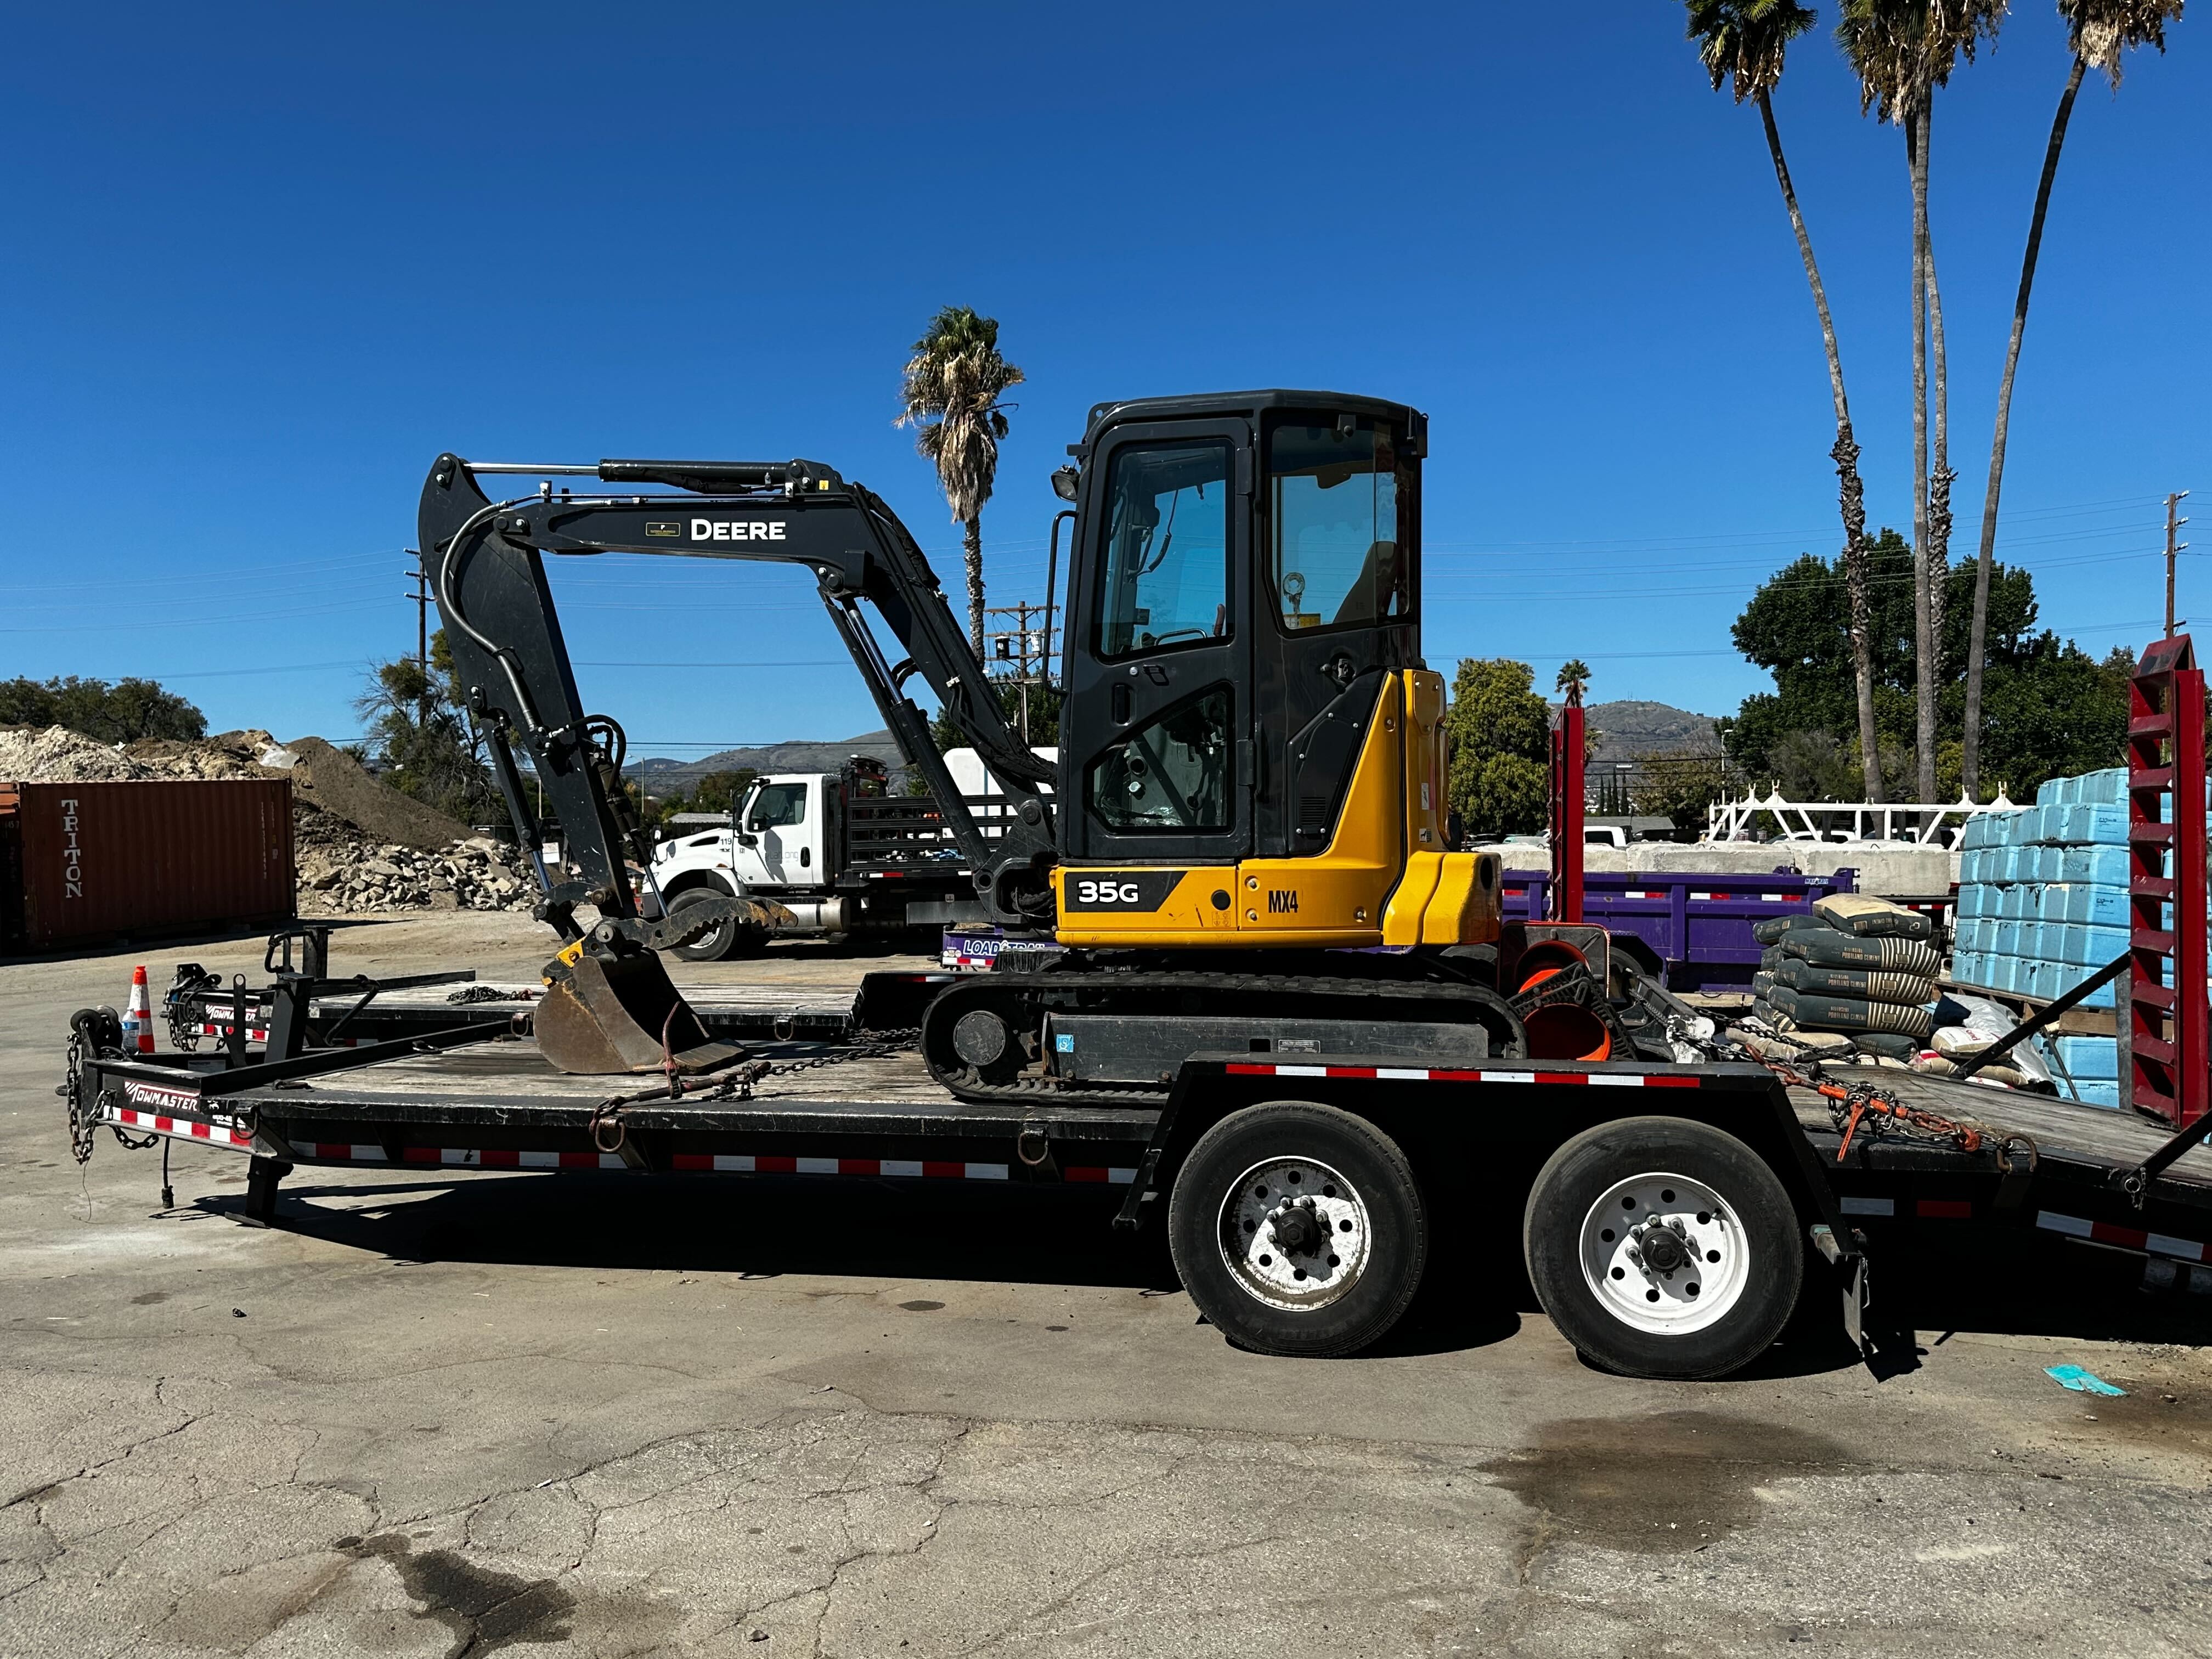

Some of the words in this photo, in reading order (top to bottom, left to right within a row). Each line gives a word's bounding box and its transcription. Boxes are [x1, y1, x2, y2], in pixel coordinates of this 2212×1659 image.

[691, 518, 786, 540] DEERE
[61, 799, 83, 898] TRITON
[1077, 880, 1139, 904] 35G
[1268, 890, 1299, 914] MX4
[963, 940, 1001, 956] LOAD
[1842, 952, 1863, 960] PORTLAND
[1828, 979, 1849, 987] PORTLAND
[206, 1005, 258, 1022] TOWMAER
[125, 1081, 199, 1111] TOWMASTER
